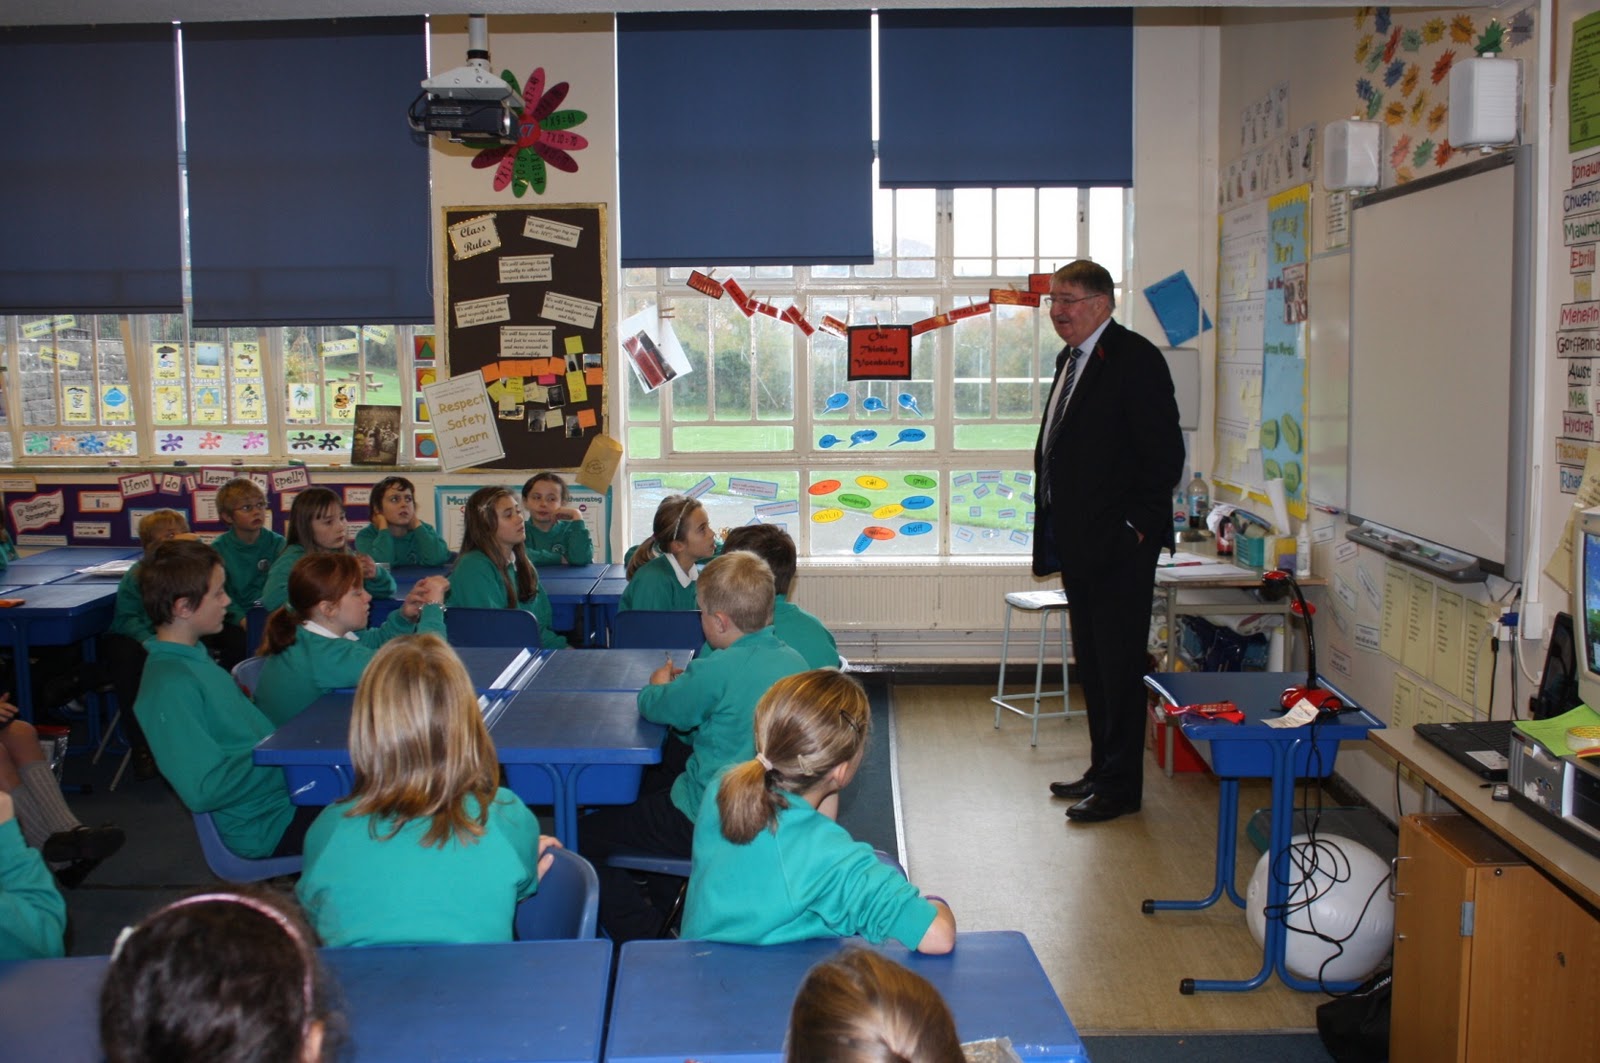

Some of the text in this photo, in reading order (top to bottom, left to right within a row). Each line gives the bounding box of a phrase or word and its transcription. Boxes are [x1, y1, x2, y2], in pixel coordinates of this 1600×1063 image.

[460, 224, 487, 238] Class
[463, 239, 492, 253] Rules
[1571, 250, 1595, 268] Ebrill
[1563, 307, 1599, 326] Mehefin
[860, 345, 897, 355] Thinking
[854, 358, 904, 368] Vocabulary
[124, 477, 150, 496] How
[165, 477, 178, 489] do
[189, 477, 194, 488] I
[274, 472, 305, 490] spell?
